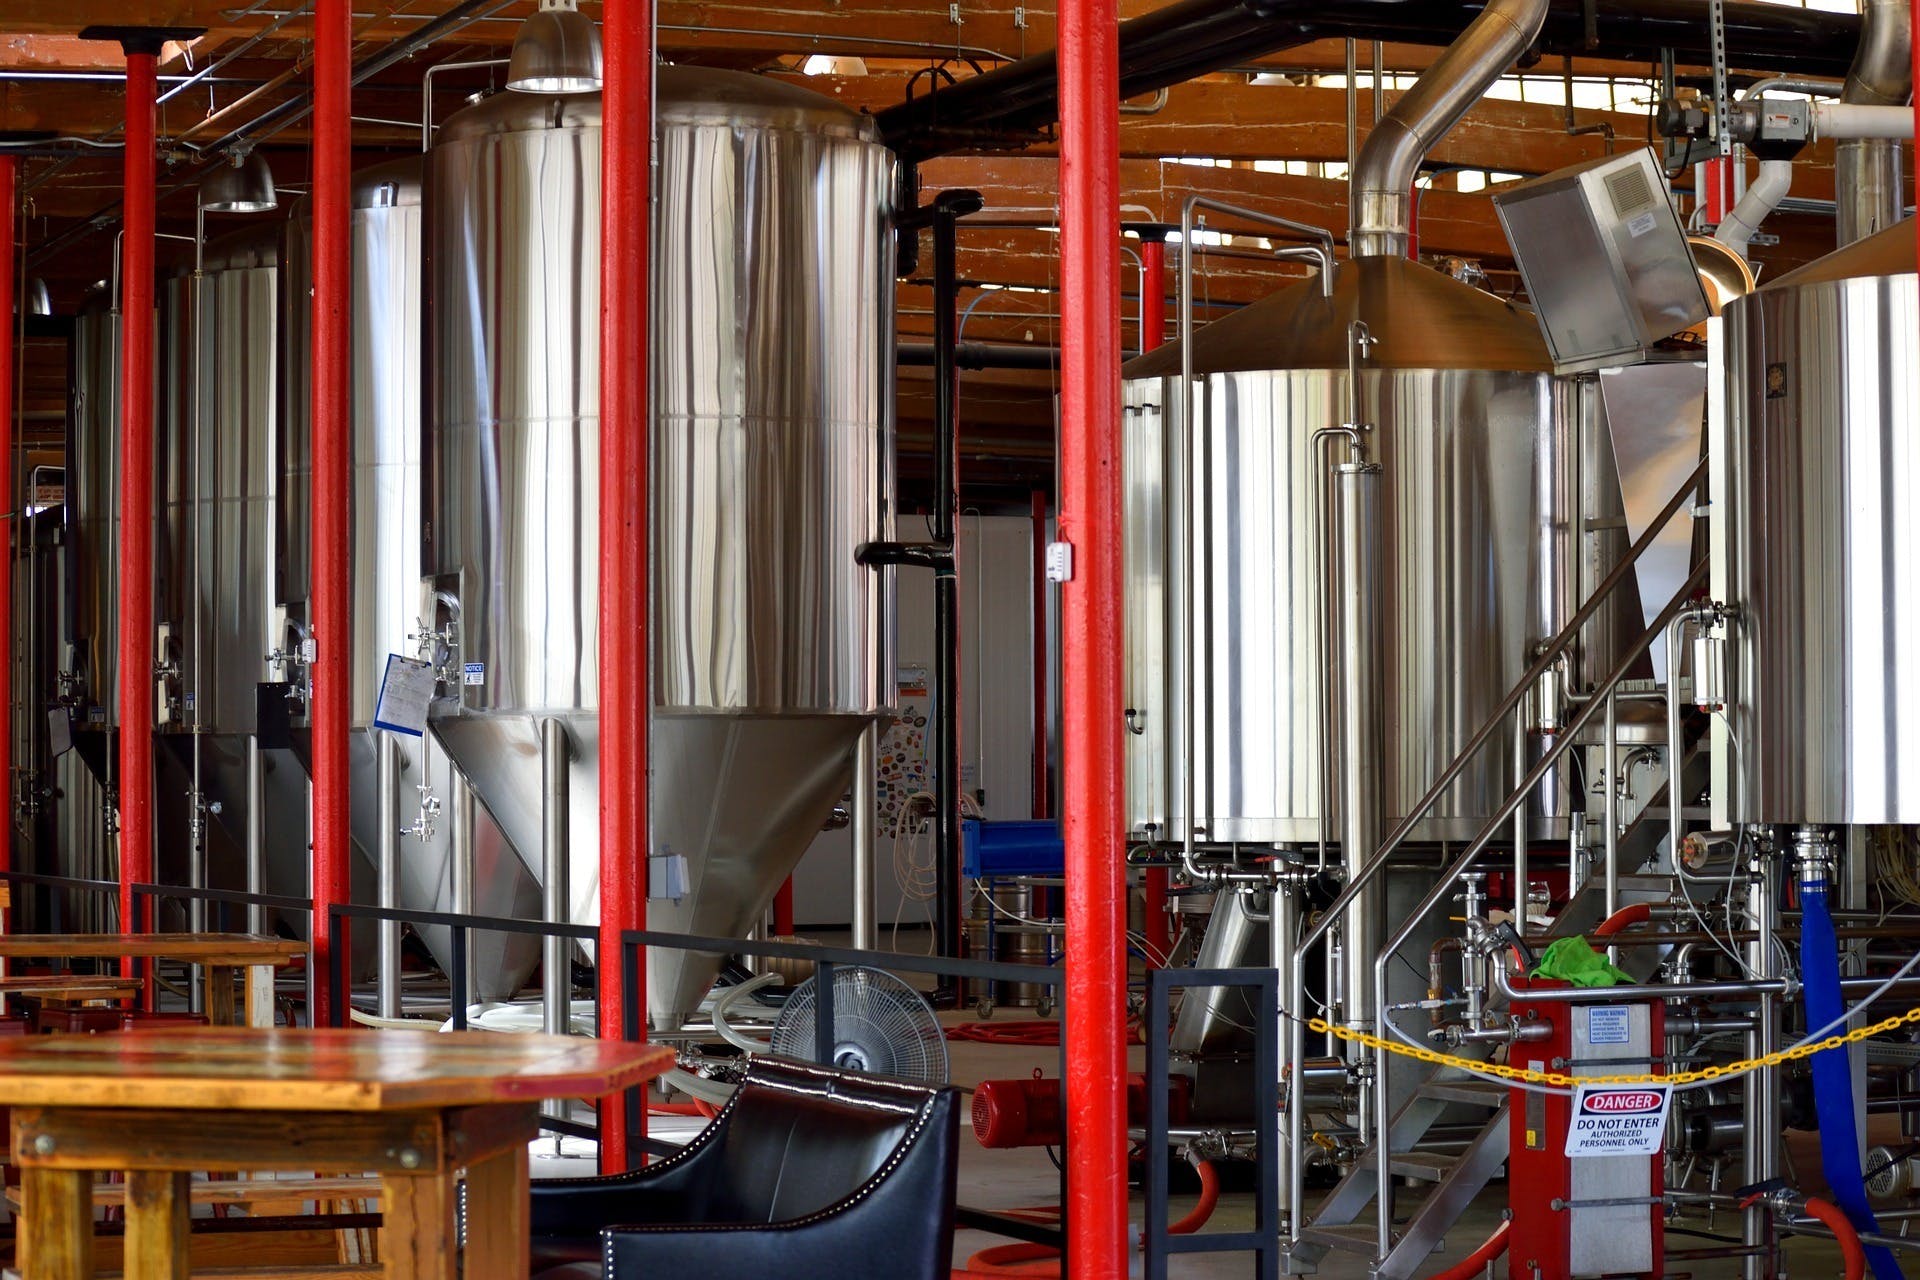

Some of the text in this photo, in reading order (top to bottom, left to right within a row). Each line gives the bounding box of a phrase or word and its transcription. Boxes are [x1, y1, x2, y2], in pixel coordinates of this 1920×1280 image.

[1593, 1095, 1653, 1109] DANGER
[1577, 1117, 1660, 1130] DO NOT ENTER
[1590, 1129, 1642, 1138] AUTHORIZED
[1579, 1137, 1649, 1147] PERSONNEL ONLY
